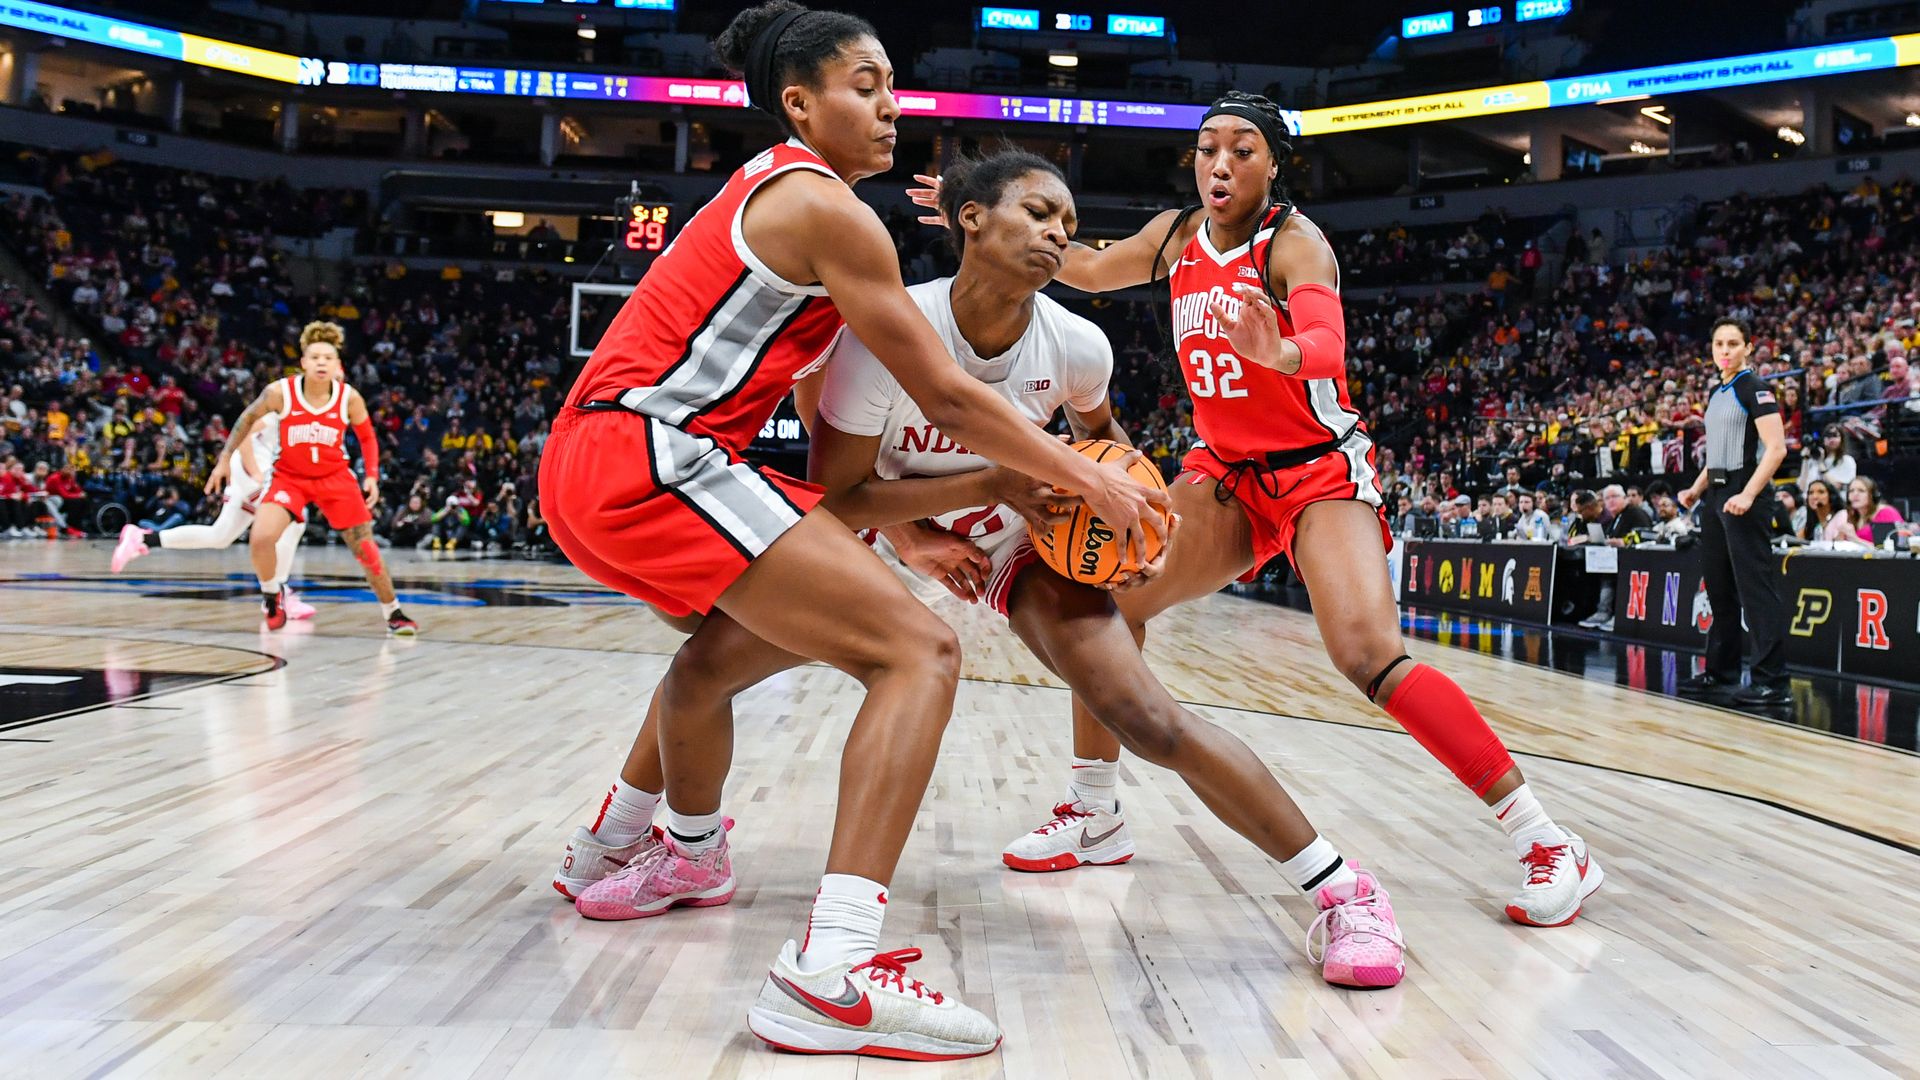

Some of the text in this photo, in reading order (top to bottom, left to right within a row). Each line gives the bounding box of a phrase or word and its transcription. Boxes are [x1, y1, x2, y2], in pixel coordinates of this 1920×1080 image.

[1003, 13, 1033, 27] TIAA
[1128, 20, 1158, 33] TIAA
[1422, 18, 1448, 34] TIAA
[1580, 60, 1794, 97] TIAA RETIREMENT IS FOR ALL
[1331, 109, 1401, 123] RETIREMENT
[1418, 104, 1441, 113] FOR
[626, 220, 664, 250] 29
[1189, 349, 1249, 399] 32
[777, 418, 801, 440] ON
[310, 446, 320, 464] 1
[1078, 516, 1115, 577] ilson
[1626, 570, 1650, 621] N
[1661, 571, 1681, 626] N
[1789, 588, 1832, 637] P
[1856, 588, 1890, 650] R
